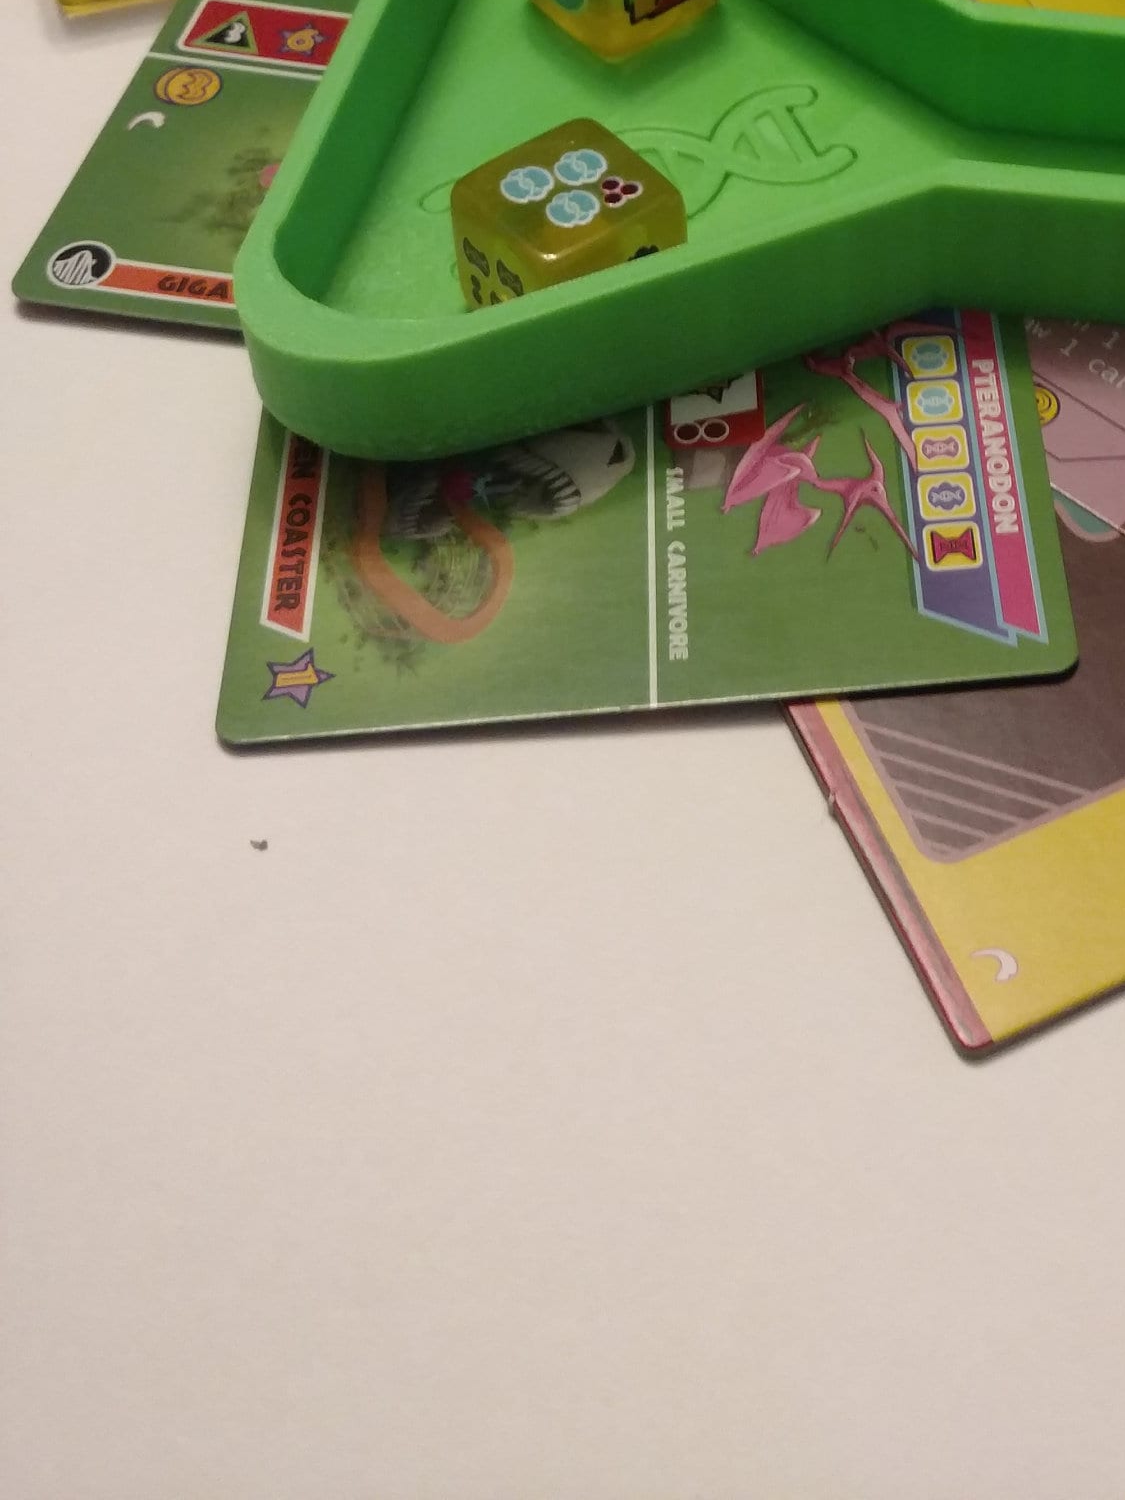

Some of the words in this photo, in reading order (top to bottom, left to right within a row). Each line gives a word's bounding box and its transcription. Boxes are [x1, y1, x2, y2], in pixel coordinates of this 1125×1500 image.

[158, 274, 229, 299] GIGA
[666, 467, 686, 531] SMALL
[972, 359, 1019, 534] PTERANODON
[275, 493, 313, 612] COASTER
[667, 540, 688, 661] CARNIVORE
